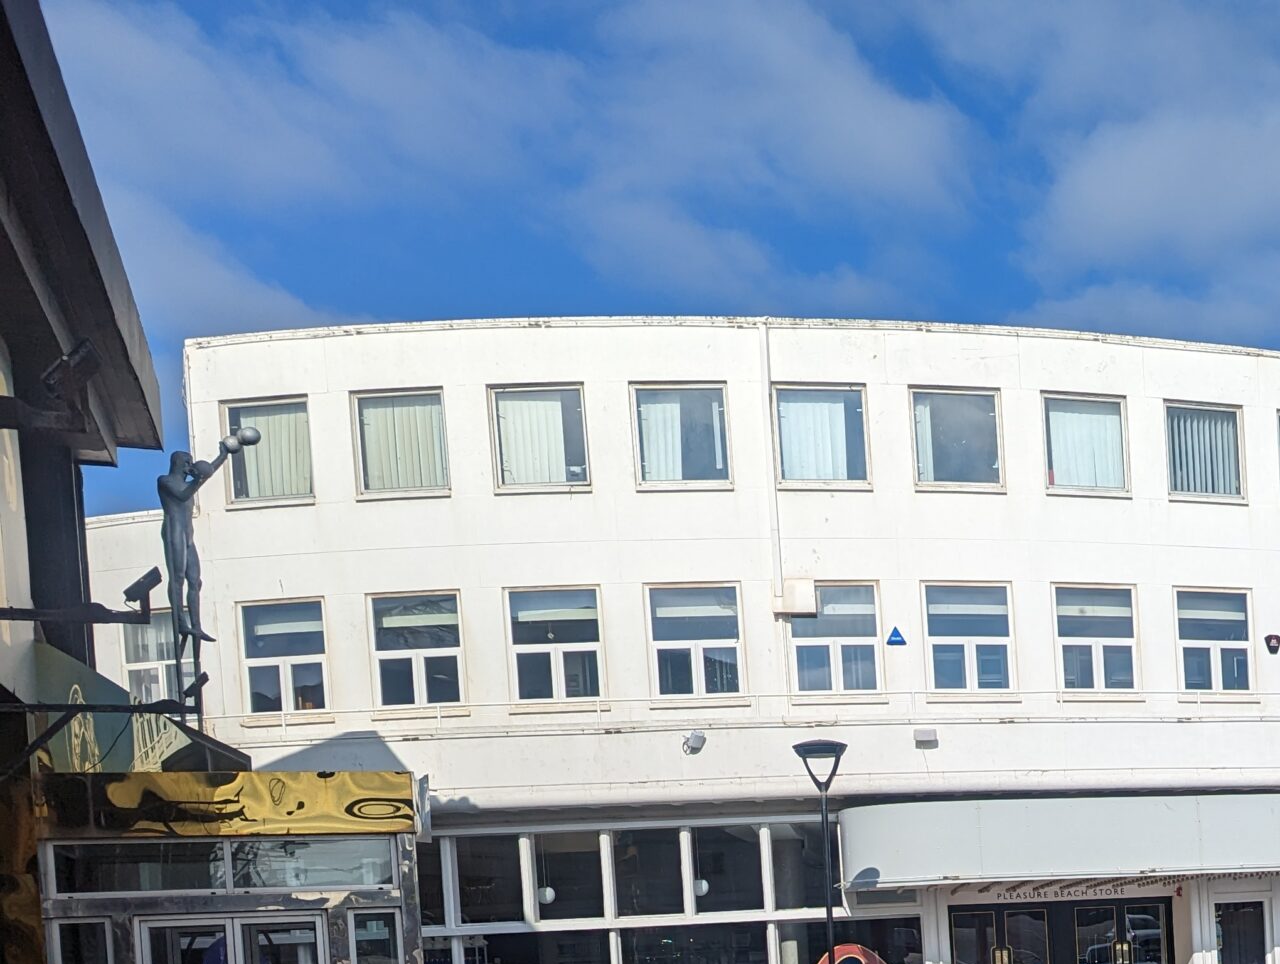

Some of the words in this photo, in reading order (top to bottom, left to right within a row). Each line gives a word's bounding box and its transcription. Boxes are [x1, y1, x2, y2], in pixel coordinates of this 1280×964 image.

[997, 891, 1048, 900] PLEASURE
[1054, 889, 1088, 898] BEACH
[1093, 888, 1125, 896] STORE
